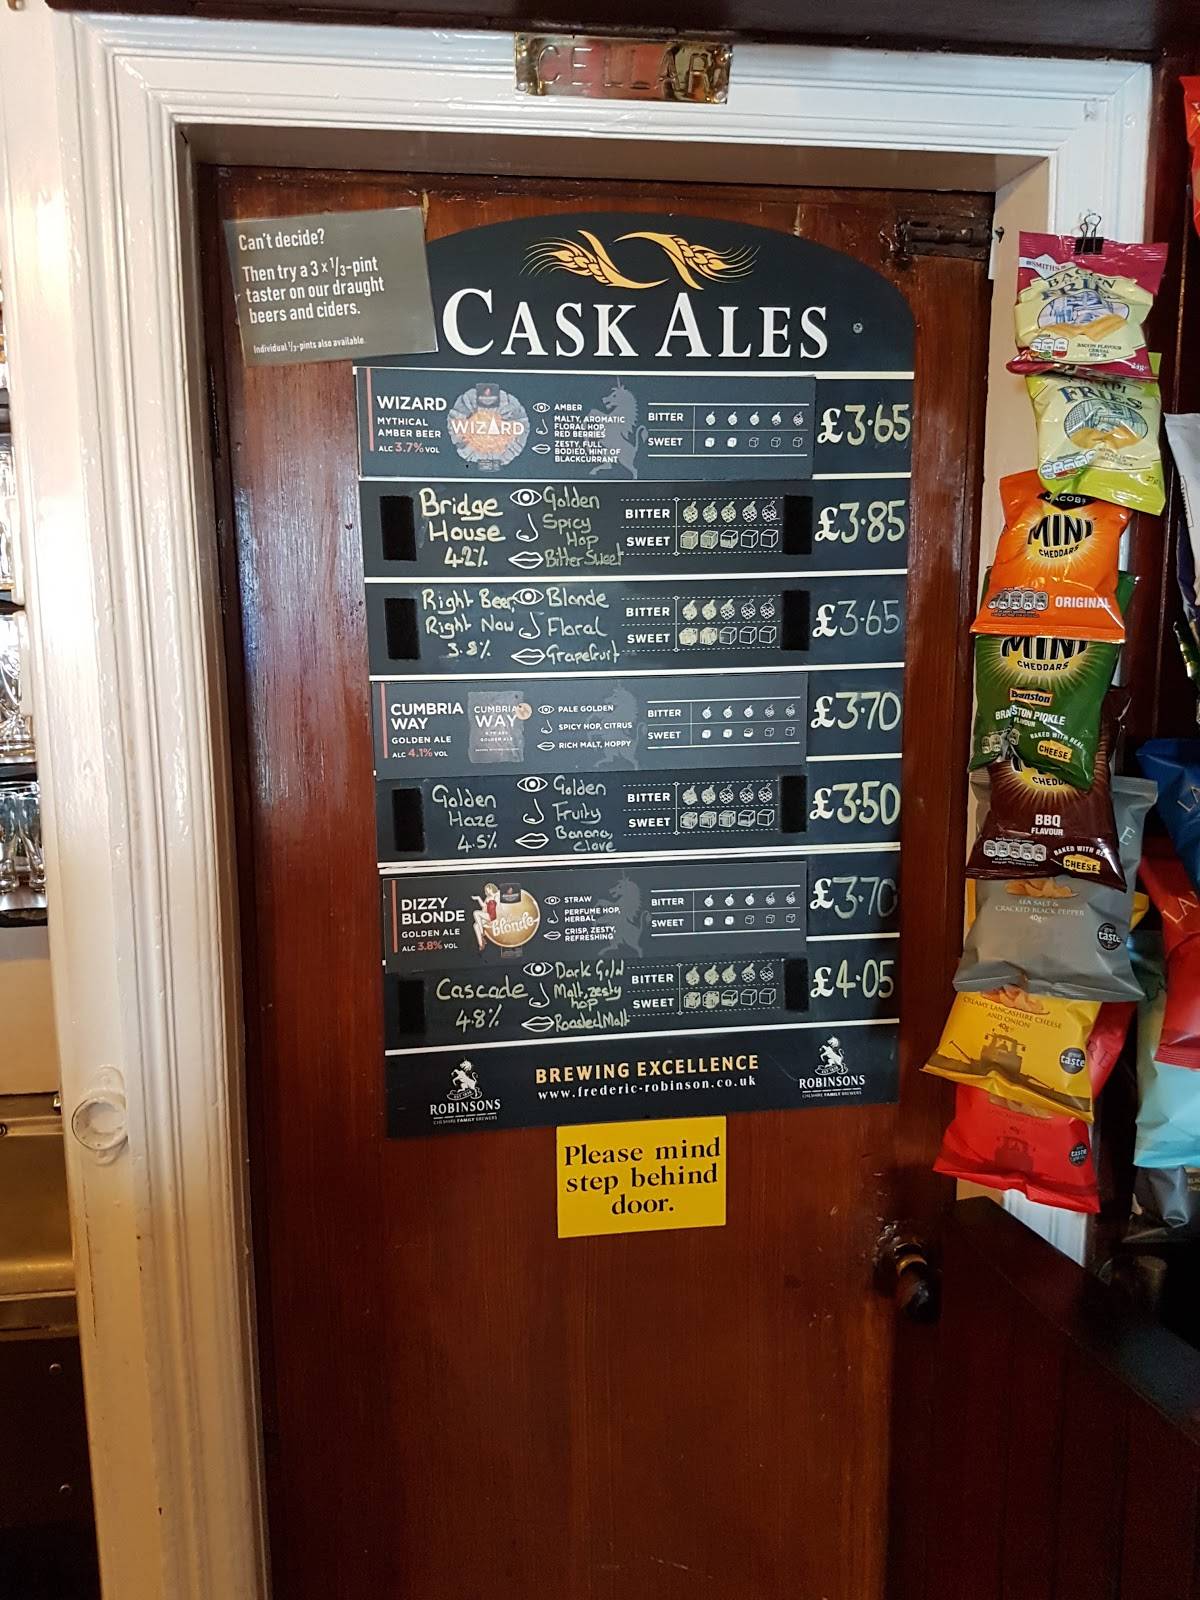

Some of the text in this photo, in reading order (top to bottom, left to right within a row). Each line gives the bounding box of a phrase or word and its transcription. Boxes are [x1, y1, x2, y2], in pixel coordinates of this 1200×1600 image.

[238, 228, 325, 252] Can't decide?
[242, 261, 319, 283] Then try a 3
[246, 276, 385, 303] taster on our draught
[249, 300, 360, 324] beers and ciders.
[442, 287, 828, 359] CASK ALES
[253, 339, 332, 354] Individual also
[377, 395, 447, 412] WIZARD
[554, 403, 583, 412] AMBER
[377, 417, 429, 427] MYTHICAL
[582, 415, 625, 424] AROMATIC
[648, 412, 684, 423] BITTER
[451, 416, 525, 436] WIZARD
[554, 423, 587, 431] FLORAL
[378, 428, 442, 439] AMBER BEER
[554, 430, 606, 439] RED BERRIES
[378, 442, 440, 454] ALC 3.7% VOL
[583, 440, 602, 448] FULL
[647, 437, 683, 447] SWEET
[589, 448, 607, 456] HINT
[609, 448, 621, 456] OF
[554, 455, 619, 464] BLACKCURRANT
[419, 487, 503, 521] Bridge
[542, 486, 600, 511] Golden
[625, 508, 670, 520] BITTER
[429, 519, 506, 542] House
[542, 513, 592, 535] Spicy
[567, 531, 599, 550] Hop
[626, 536, 671, 547] SWEET
[1038, 544, 1080, 559] CHEDDARS
[421, 588, 474, 615] Right
[546, 587, 609, 609] Blonde
[1055, 596, 1110, 609] ORIGINAL
[625, 606, 670, 617] BITTER
[425, 613, 514, 640] Right Now
[547, 616, 608, 637] Floral
[627, 633, 670, 644] SWEET
[546, 639, 621, 664] Grapefruit
[1017, 660, 1069, 671] CHEDDARS
[390, 702, 464, 716] CUMBRIA
[580, 704, 614, 713] GOLDEN
[647, 708, 681, 718] BITTER
[391, 717, 428, 731] WAY
[475, 714, 517, 728] WAY
[558, 723, 580, 732] SPICY
[604, 721, 632, 730] CITRUS
[391, 735, 452, 745] GOLDEN ALE
[647, 730, 681, 740] SWEET
[558, 742, 578, 750] RICH
[604, 740, 632, 749] HOPPY
[392, 748, 449, 759] ALC 4.1% VOL
[1039, 745, 1069, 760] CHEESE
[553, 774, 607, 797] Golden
[431, 784, 497, 809] Golden
[627, 792, 670, 803] BITTER
[448, 810, 499, 828] Haze
[551, 800, 602, 824] Fruity
[628, 817, 670, 828] SWEET
[1035, 814, 1061, 828] BBQ
[1031, 827, 1064, 837] FLAVOUR
[1053, 845, 1094, 856] BAKED WITH
[1065, 859, 1097, 873] CHEESE
[401, 896, 449, 912] DIZZY
[564, 895, 592, 904] STRAW
[651, 897, 684, 907] BITTER
[401, 910, 465, 926] BLONDE
[564, 908, 601, 916] PERFUME
[564, 914, 596, 923] HERBAL
[651, 918, 684, 928] SWEET
[401, 927, 461, 939] GOLDEN ALE
[564, 933, 614, 942] REFRESHING
[402, 941, 458, 953] ALC 3.8% VOL
[555, 959, 624, 981] Dark Gold
[631, 973, 674, 984] BITTER
[436, 974, 529, 1001] Cascade
[587, 979, 622, 1001] zesty
[571, 997, 599, 1011] hop
[632, 997, 675, 1009] SWEET
[555, 1008, 630, 1032] Roasted Malt
[1060, 1055, 1085, 1067] taste
[535, 1054, 759, 1084] BREWING EXCELLENCE
[538, 1075, 757, 1101] www.frederic-robinson.co.uk
[799, 1074, 866, 1090] ROBINSONS
[430, 1098, 501, 1116] ROBINSONS
[564, 1136, 720, 1167] Please mind
[566, 1162, 718, 1195] step behind
[611, 1194, 674, 1215] door.
